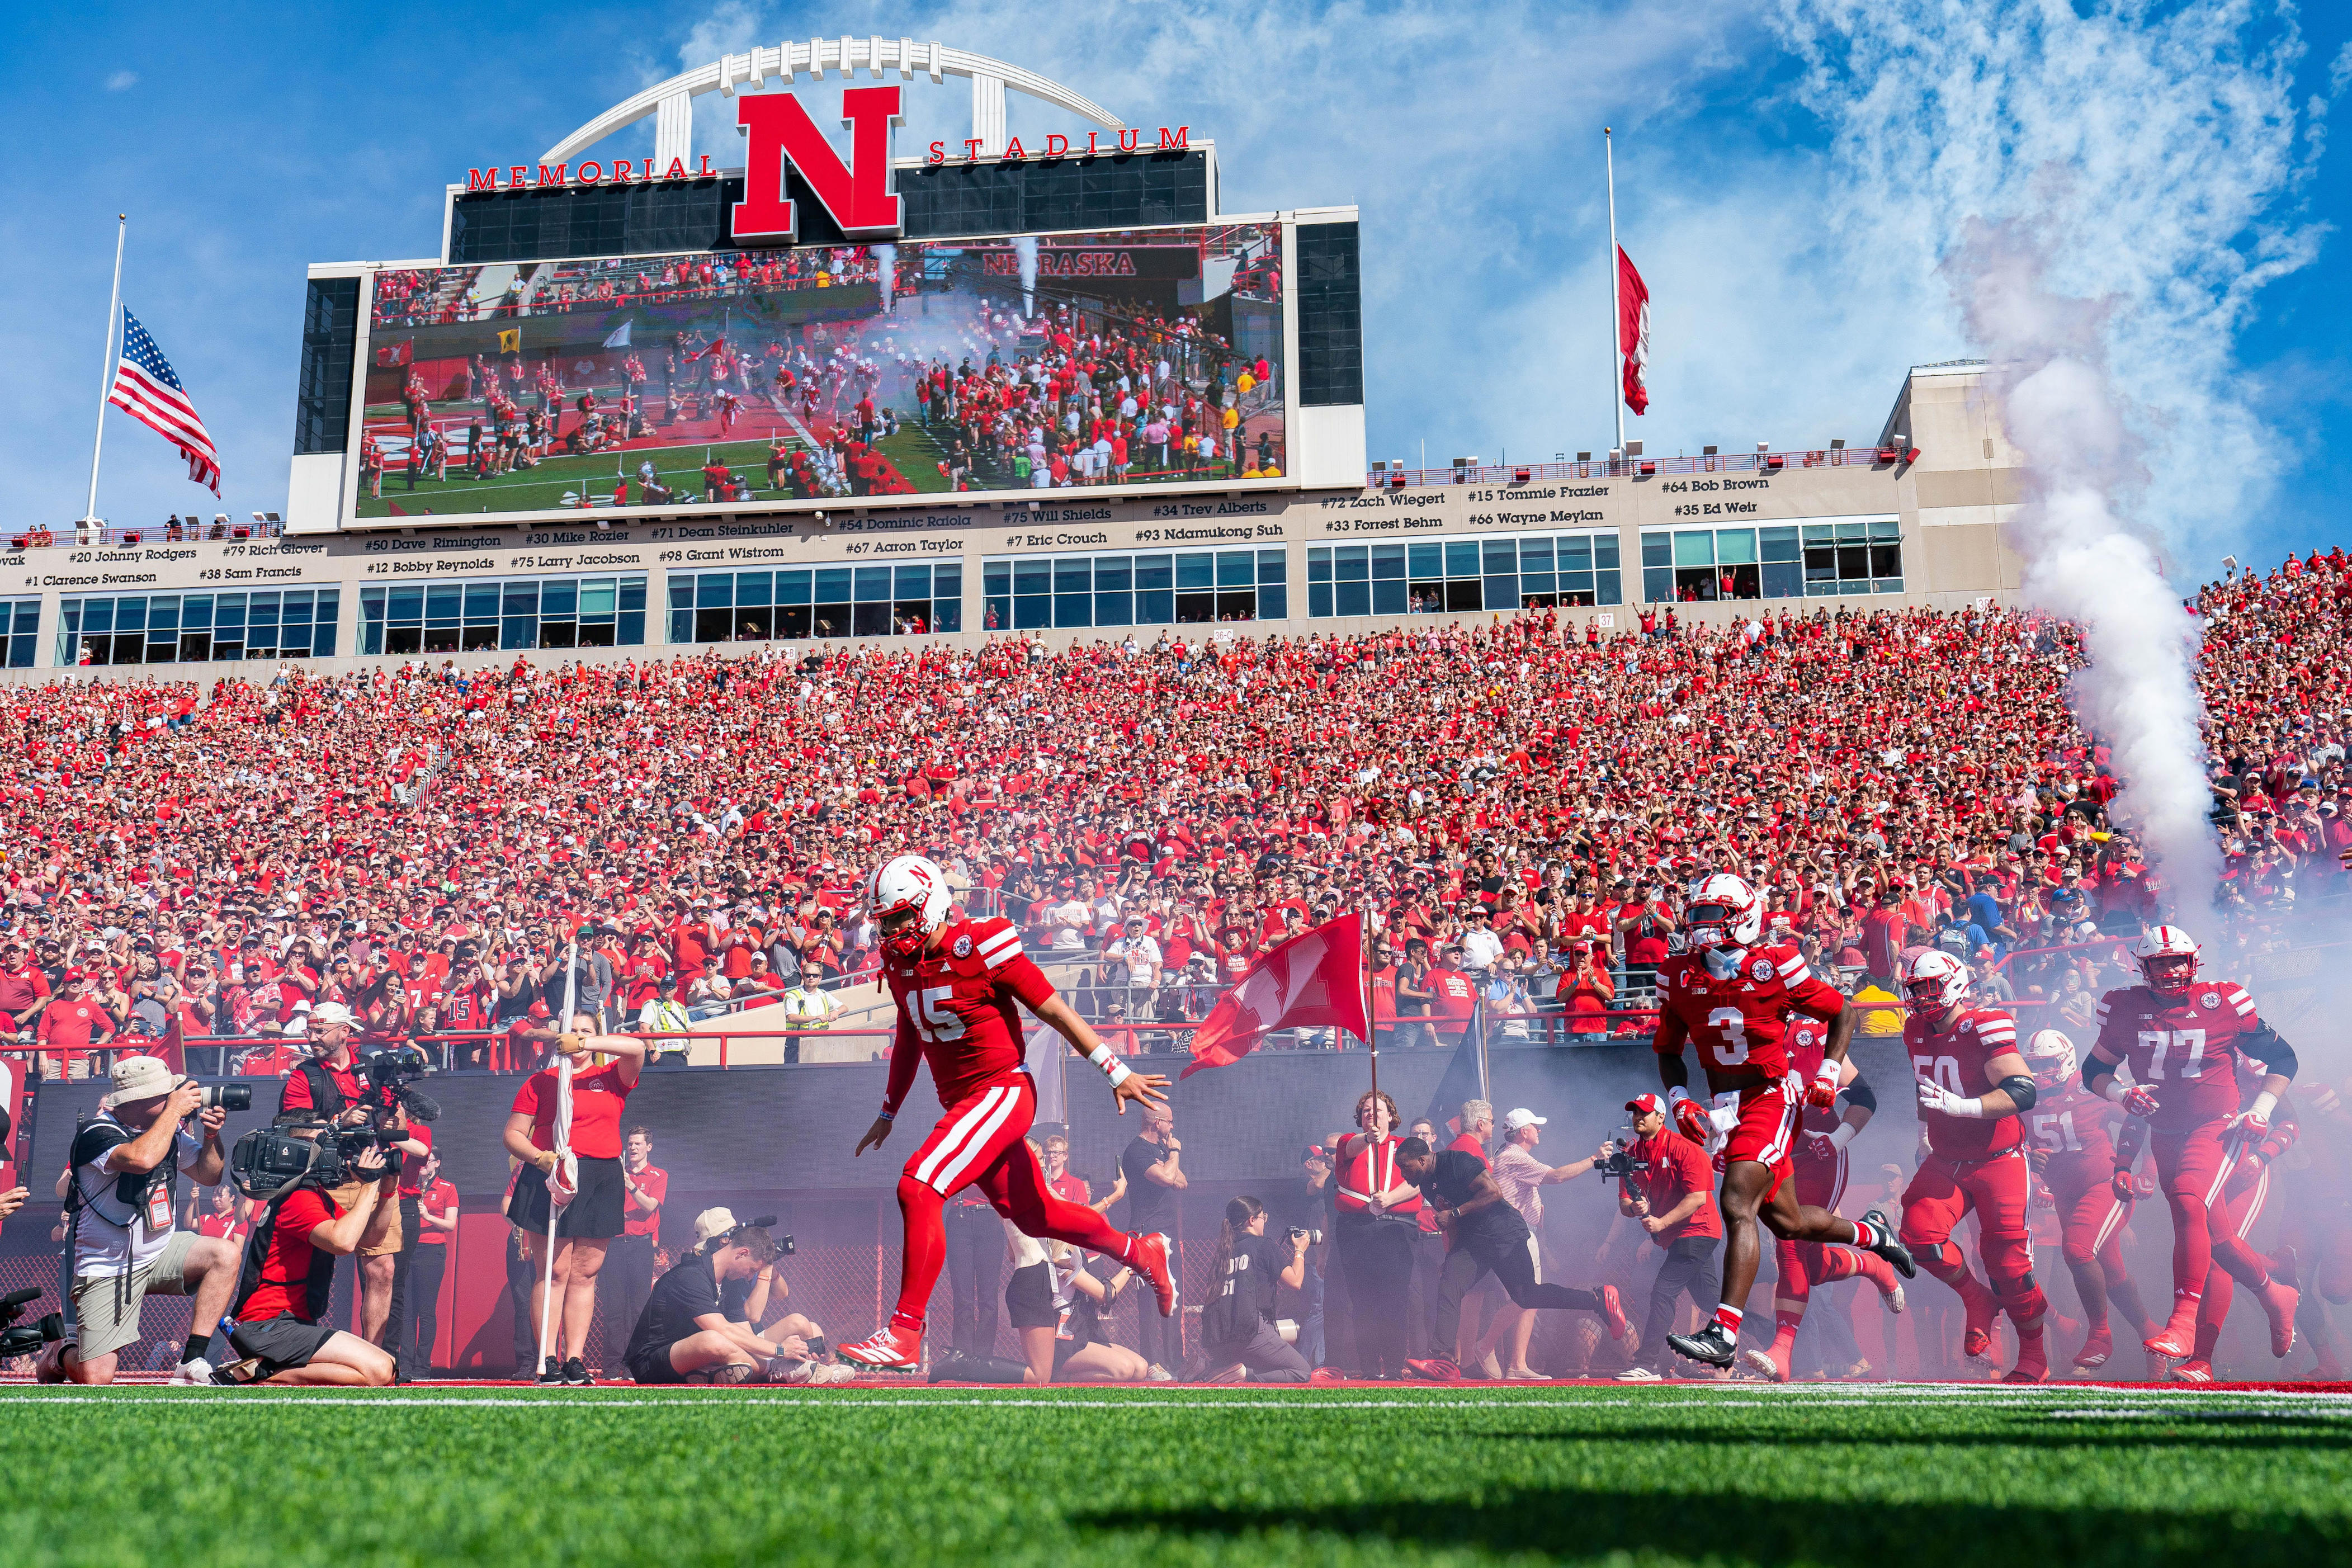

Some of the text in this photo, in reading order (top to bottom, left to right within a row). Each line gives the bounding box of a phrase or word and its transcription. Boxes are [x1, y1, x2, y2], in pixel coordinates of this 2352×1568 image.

[928, 125, 1190, 165] STADIUM
[730, 84, 905, 240] N
[467, 155, 717, 192] MEMORIAL
[983, 252, 1137, 277] NERASKA
[1468, 485, 1609, 502] #15 Tommie Frazier
[1662, 480, 1769, 493] #64 Bob Brown
[1321, 493, 1444, 509] #72 Zach Wiegert
[1004, 508, 1111, 523] #75 Will Shields
[1154, 502, 1266, 516] #34 Trev Alberts
[1675, 502, 1757, 516] #35 Ed Weir
[839, 516, 971, 530] #54 Dominic Raiola
[1326, 517, 1443, 531] #33 Forrest Behm
[1469, 510, 1603, 525] #66 Wayne Meylan
[526, 530, 629, 544] #30 Mike Rozier
[651, 523, 793, 539] #71 Dean Steinkuhler
[1136, 525, 1283, 541] #93 Ndamukong Suh
[365, 536, 500, 550] #50 Dave Rimington
[1007, 532, 1107, 546] #7 Eric Crouch
[223, 544, 323, 556] #79 Rich Glover
[846, 539, 963, 554] #67 Aaron Taylor
[69, 549, 196, 563] #20 Johnny Rodgers
[511, 554, 640, 568] #75 Larry Jacobson
[659, 547, 783, 561] #98 Grant Wistrom
[200, 566, 301, 579] #38 Sam Francis
[367, 559, 494, 573] #12 Bobby Reynolds
[26, 574, 156, 586] #1 Clarence Swanson
[1978, 599, 1989, 611] 38
[1601, 615, 1611, 626] 37
[1215, 631, 1232, 640] 36-C
[1694, 829, 1705, 839] N
[909, 865, 932, 888] N
[410, 989, 422, 1008] 7
[448, 999, 470, 1022] 15
[905, 985, 966, 1042] 15
[1707, 1007, 1750, 1066] 3
[2138, 1028, 2206, 1079] 77
[358, 1072, 367, 1080] N
[1913, 1055, 1966, 1098] 50
[2032, 1110, 2082, 1154] 51
[152, 1191, 166, 1202] PHOTO
